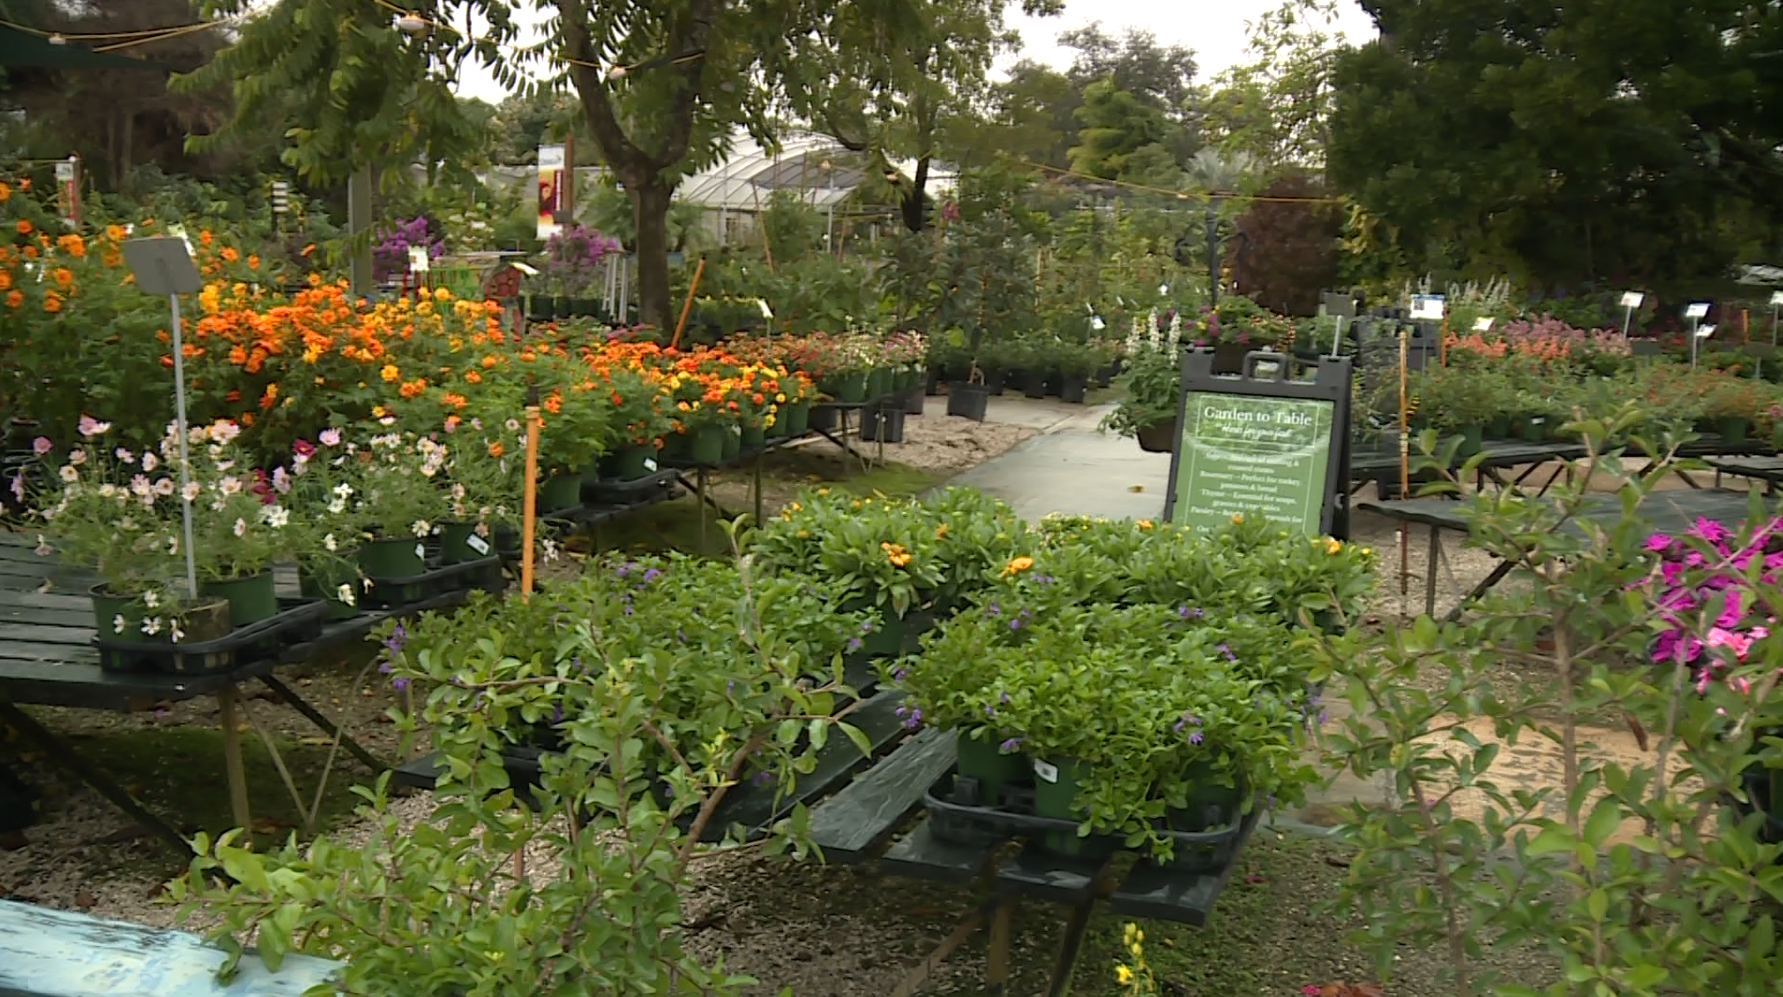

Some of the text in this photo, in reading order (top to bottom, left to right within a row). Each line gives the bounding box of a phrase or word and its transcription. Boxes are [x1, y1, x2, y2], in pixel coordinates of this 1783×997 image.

[1204, 406, 1312, 426] Garden to Table
[1266, 475, 1277, 483] for
[1264, 494, 1275, 502] for
